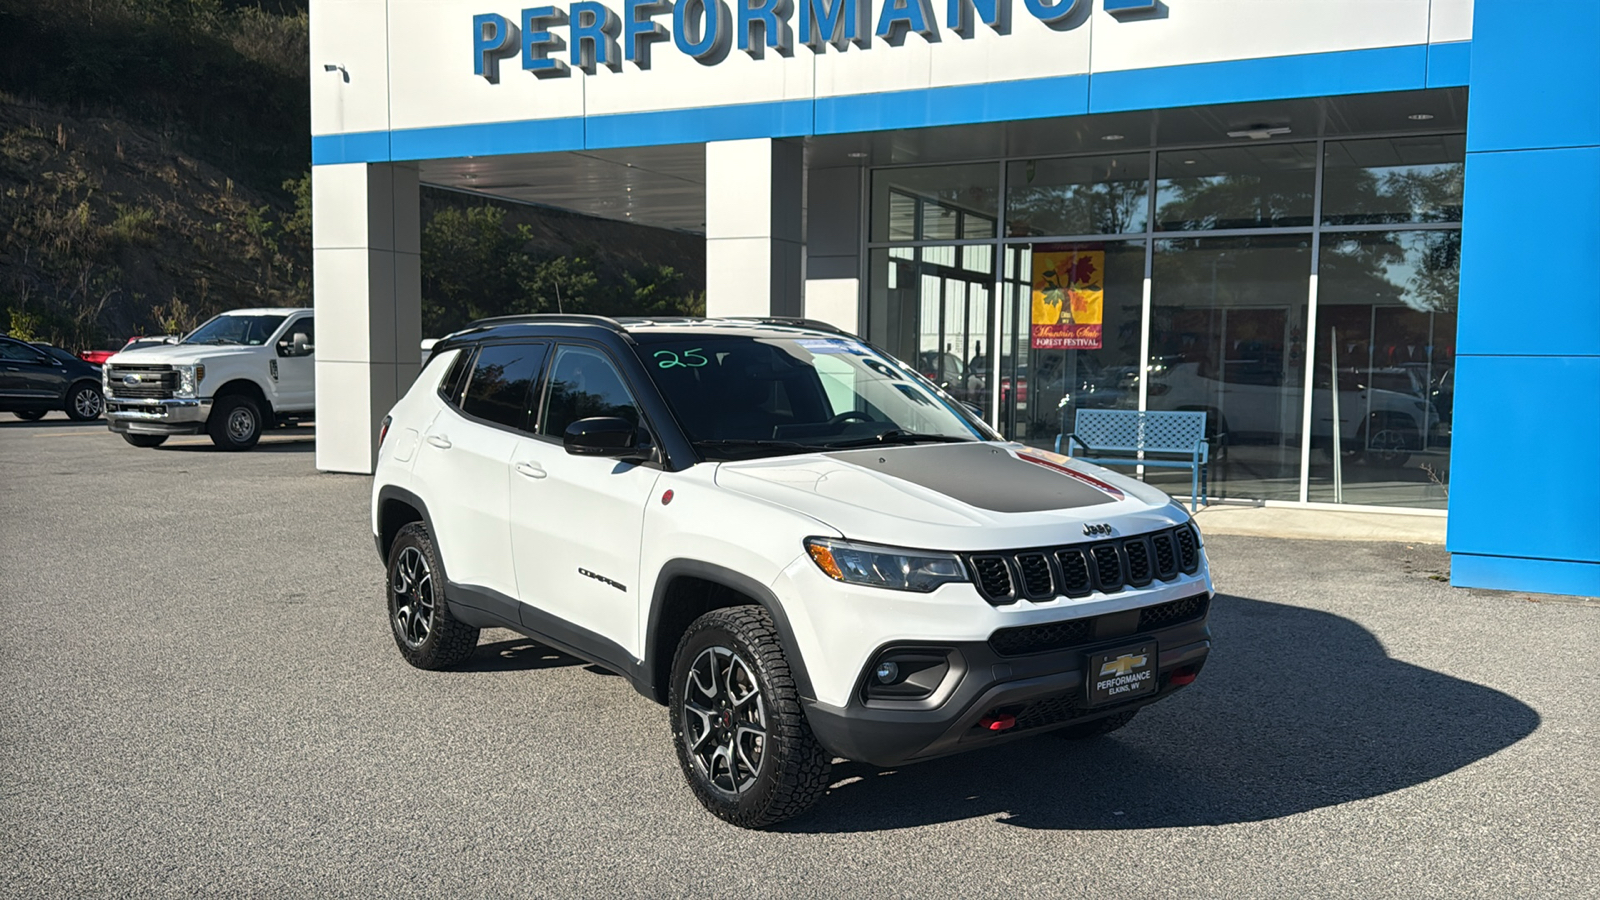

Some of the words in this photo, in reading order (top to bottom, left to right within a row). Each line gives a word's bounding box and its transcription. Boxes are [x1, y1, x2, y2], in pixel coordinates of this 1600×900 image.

[1036, 338, 1062, 346] FOREST
[1063, 338, 1099, 346] FESTIVAL
[653, 348, 708, 369] 25
[1082, 522, 1112, 536] Jeep
[1097, 670, 1151, 691] PERFORMANCE
[1108, 684, 1130, 695] ELKINS,
[1131, 681, 1140, 689] WV
